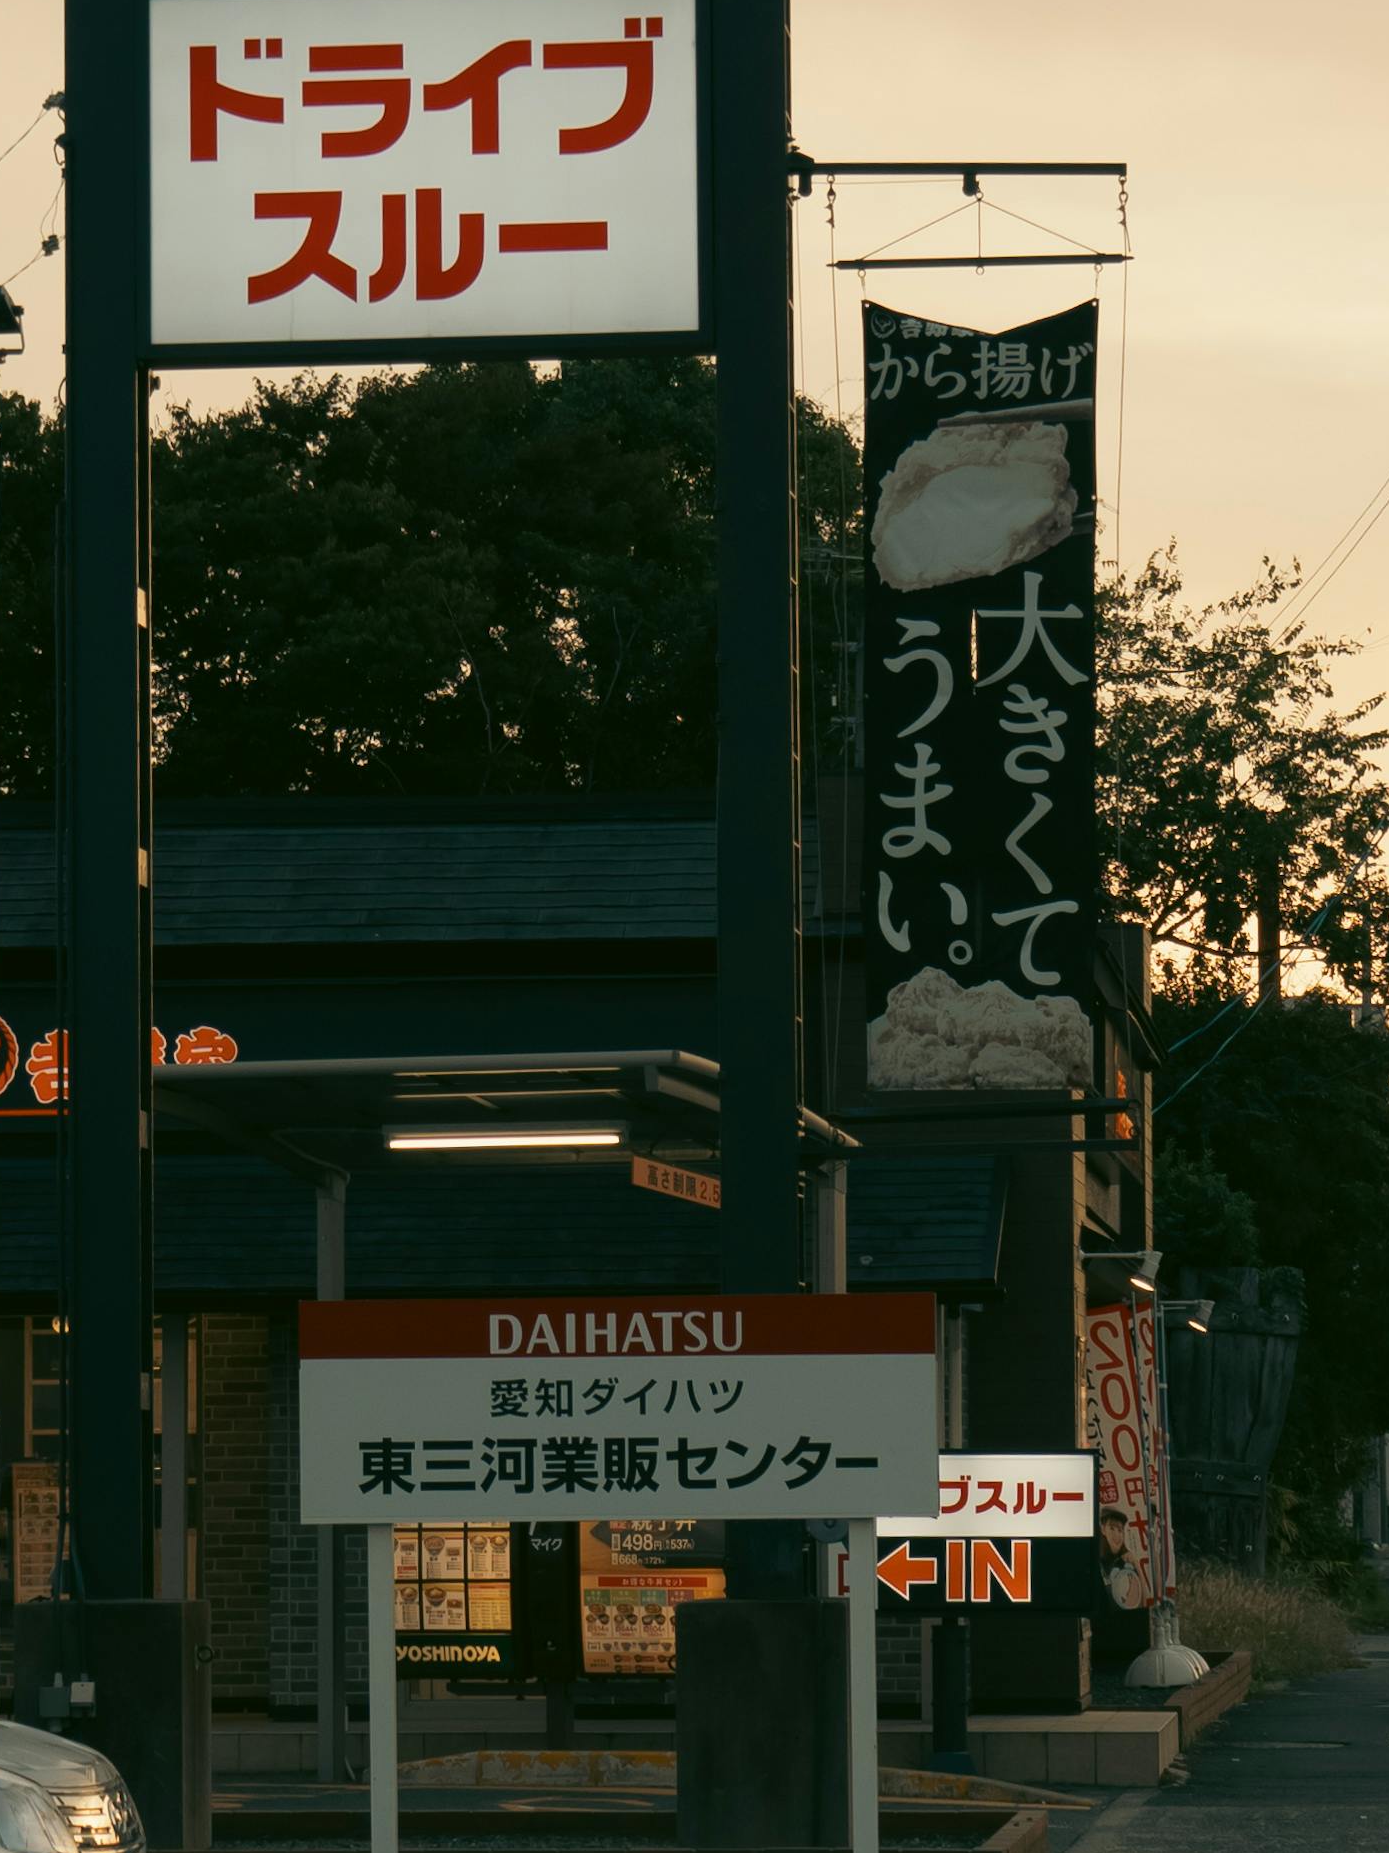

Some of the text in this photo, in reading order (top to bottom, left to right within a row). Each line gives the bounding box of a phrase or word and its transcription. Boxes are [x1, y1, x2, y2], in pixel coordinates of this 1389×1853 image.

[189, 16, 664, 163] ドライブ
[247, 187, 609, 305] スルー
[867, 340, 1094, 401] から揚げ
[878, 617, 973, 966] うまい。
[975, 570, 1089, 986] 大きくて
[488, 1310, 744, 1355] DAIHATSU
[488, 1377, 745, 1419] 愛知ダイハツ
[357, 1434, 880, 1495] 東三河業販センター
[939, 1474, 1084, 1515] ブスルー
[530, 1538, 563, 1552] マイク
[945, 1539, 1032, 1602] IN
[395, 1645, 501, 1662] YOSHINOYA
